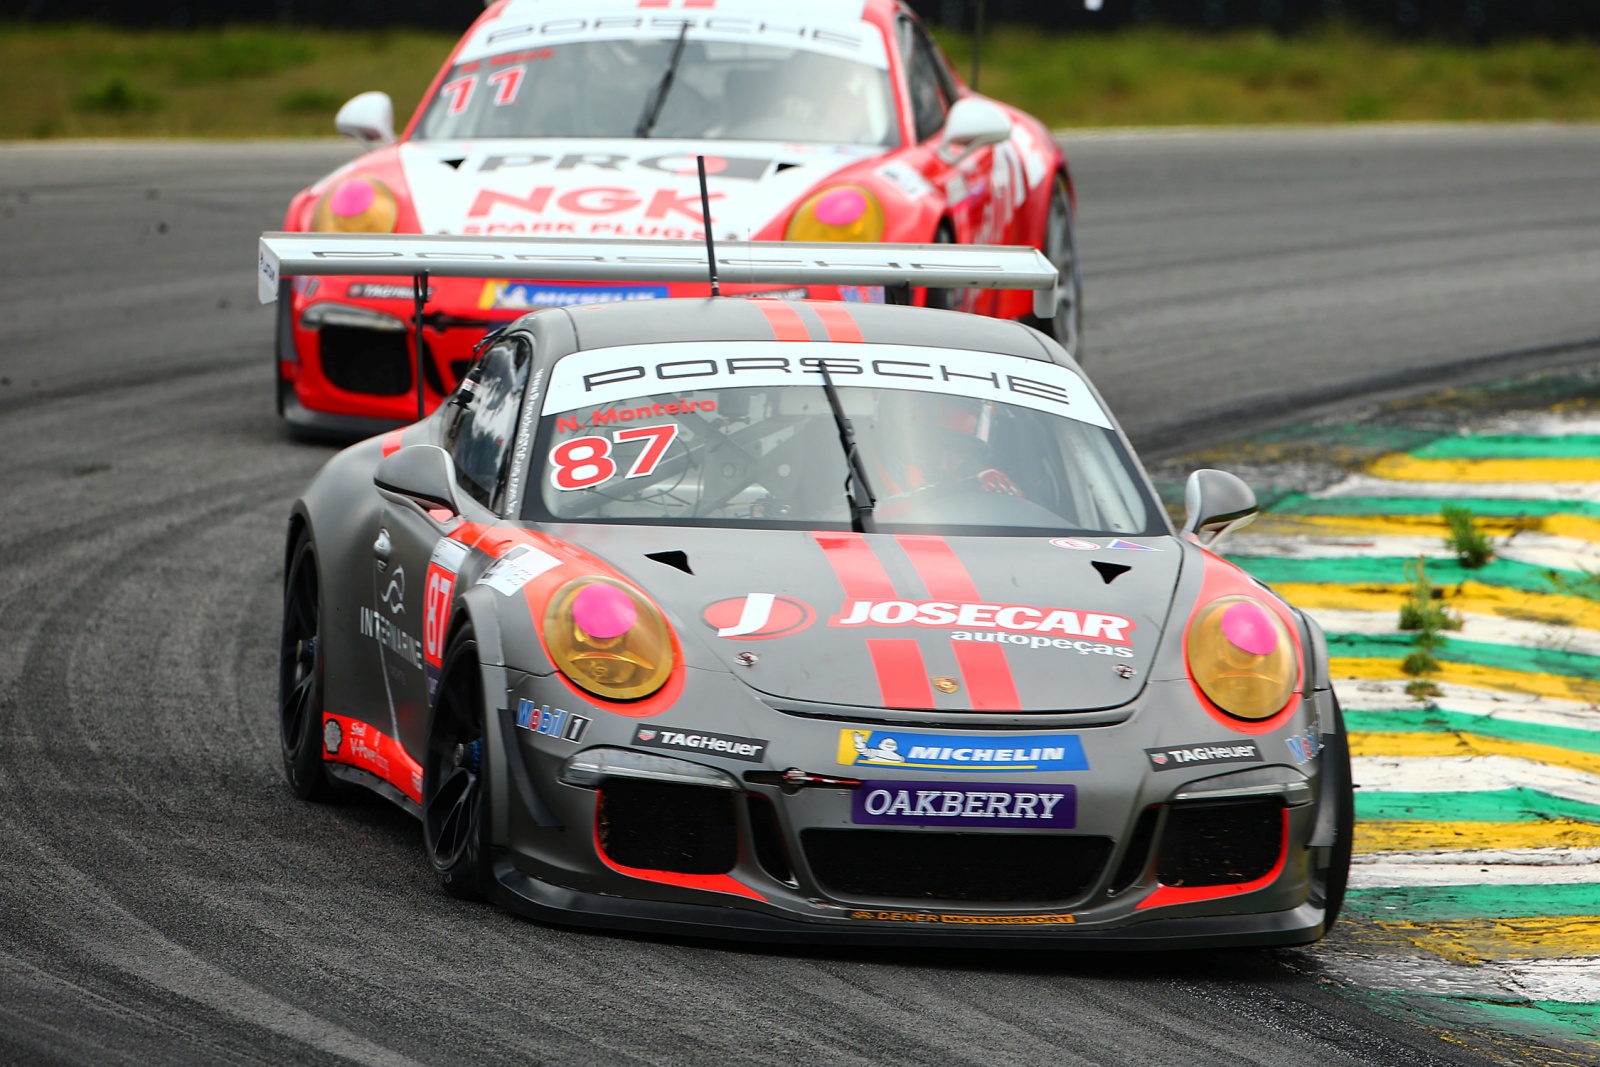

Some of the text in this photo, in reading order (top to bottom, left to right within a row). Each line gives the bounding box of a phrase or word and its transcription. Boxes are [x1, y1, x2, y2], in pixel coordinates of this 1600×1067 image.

[487, 17, 864, 51] PORSCHE
[443, 64, 527, 116] 11
[467, 186, 727, 222] NGK
[462, 222, 708, 241] SPARK PLUGS
[312, 252, 1003, 271] PORSCHE
[583, 357, 1070, 405] PORSCHE
[556, 397, 717, 434] N. Monteiro
[548, 424, 679, 490] 87
[427, 572, 455, 659] 87
[839, 601, 1130, 641] JOSECAR
[951, 630, 1134, 658] autopeças
[516, 697, 569, 739] Mobil
[908, 746, 1066, 761] MICHELIN
[863, 789, 1065, 819] OAKBERRY
[877, 911, 939, 922] DENER
[942, 914, 1073, 924] MOTORSPORT
